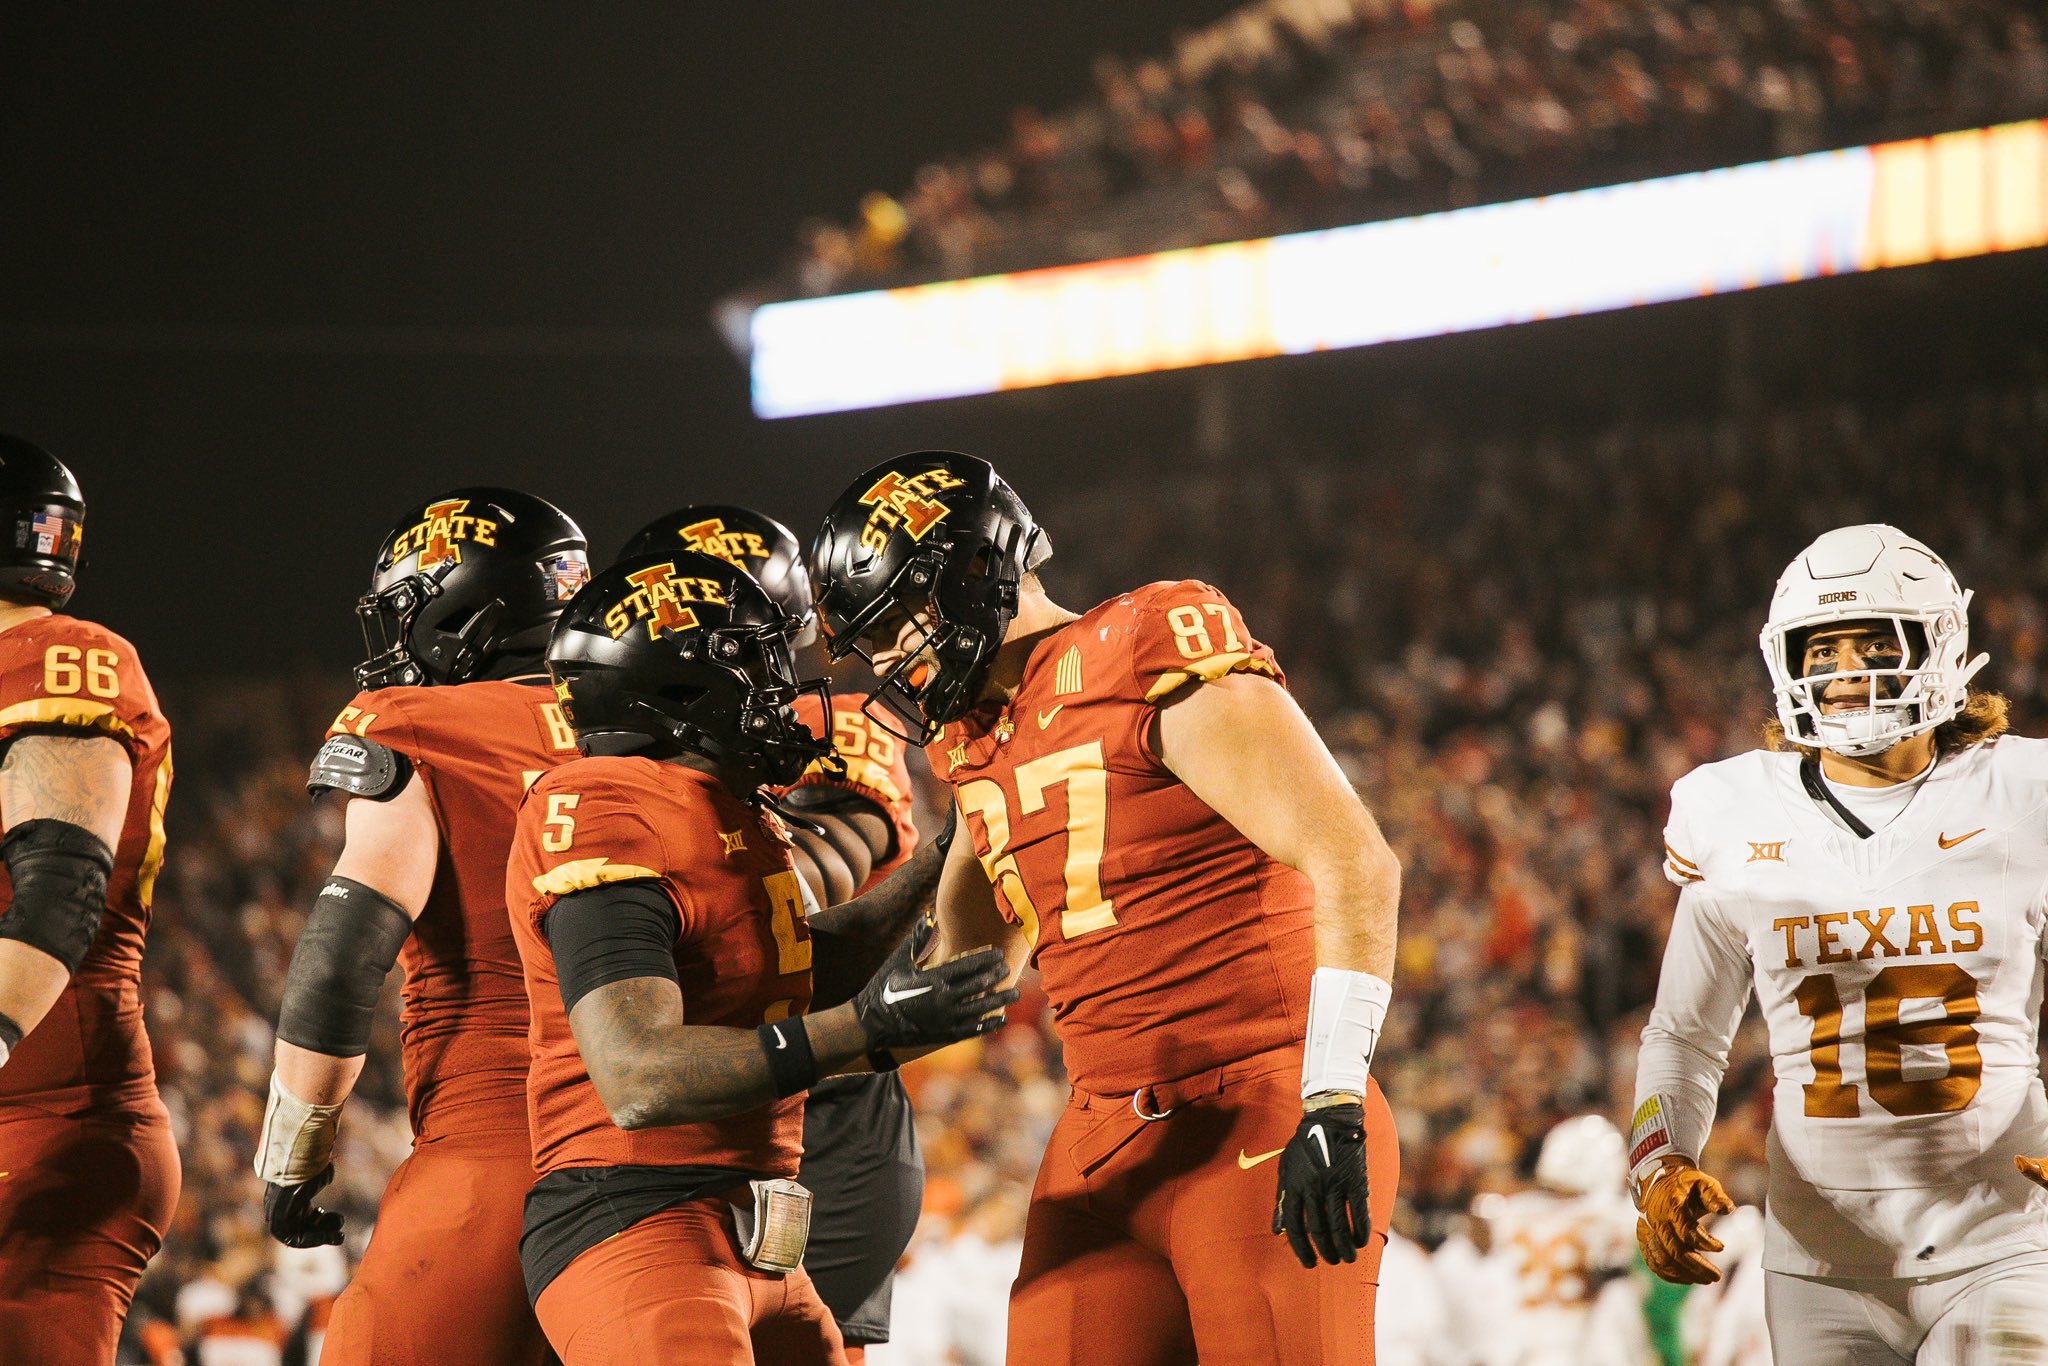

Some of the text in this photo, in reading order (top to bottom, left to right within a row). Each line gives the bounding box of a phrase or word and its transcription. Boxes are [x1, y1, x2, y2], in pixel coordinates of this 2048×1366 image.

[393, 515, 497, 565] STATE
[861, 469, 964, 560] STATE
[685, 532, 771, 558] ATE
[603, 577, 730, 640] STATE
[1818, 590, 1858, 606] HORNS
[1167, 602, 1246, 660] 87
[44, 644, 120, 699] 66
[833, 710, 896, 768] 55
[541, 793, 581, 852] 5
[957, 740, 1120, 951] 87
[1746, 840, 1787, 863] XII
[1773, 900, 1984, 969] TEXAS
[1794, 962, 1983, 1118] 18
